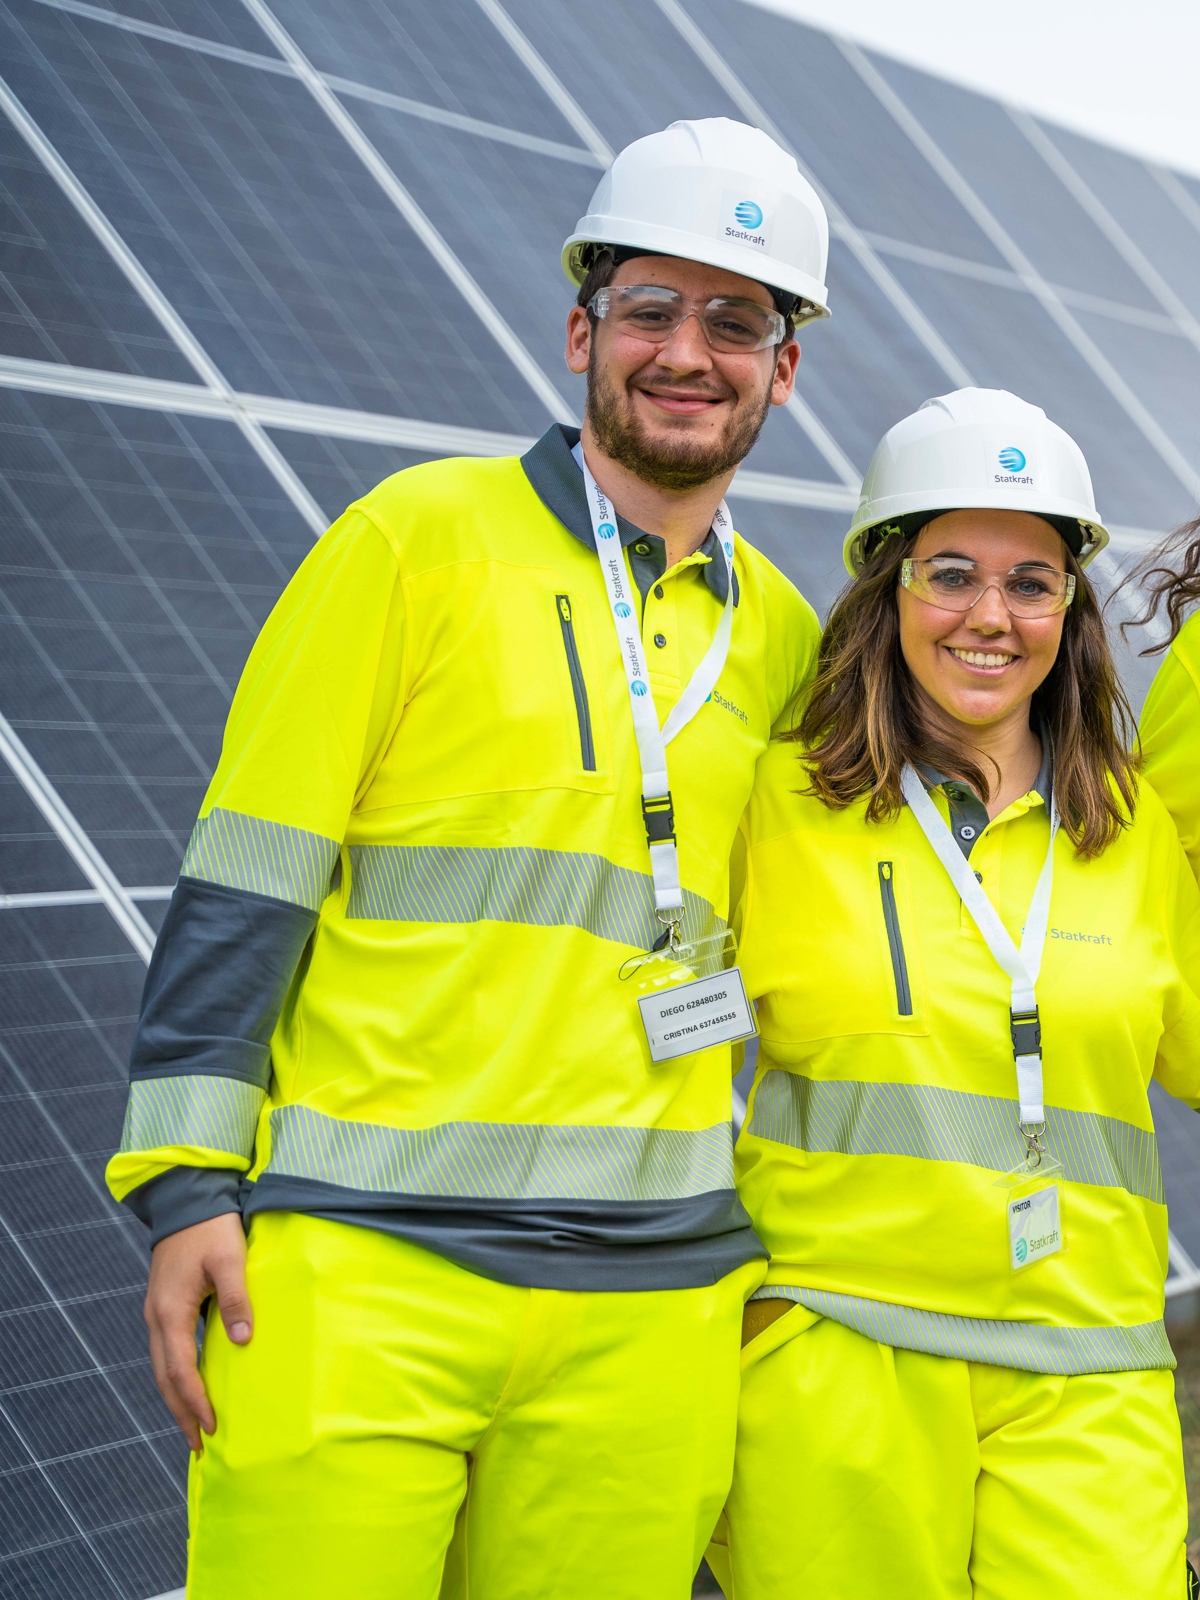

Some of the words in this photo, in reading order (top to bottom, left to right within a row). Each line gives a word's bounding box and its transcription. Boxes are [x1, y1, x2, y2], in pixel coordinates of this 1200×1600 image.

[725, 227, 765, 246] Statkraft
[994, 474, 1034, 485] Statkraft
[608, 559, 624, 599] Statkraft
[626, 637, 641, 676] Statkraft
[713, 690, 748, 726] Statkraft
[1051, 928, 1112, 946] Statkraft
[660, 1004, 685, 1018] DIEGO
[686, 991, 727, 1010] 628480305
[664, 1025, 698, 1041] CRISTINA
[700, 1012, 737, 1029] 637455355
[1012, 1200, 1031, 1214] VISITOR
[1030, 1230, 1058, 1252] Statkraft
